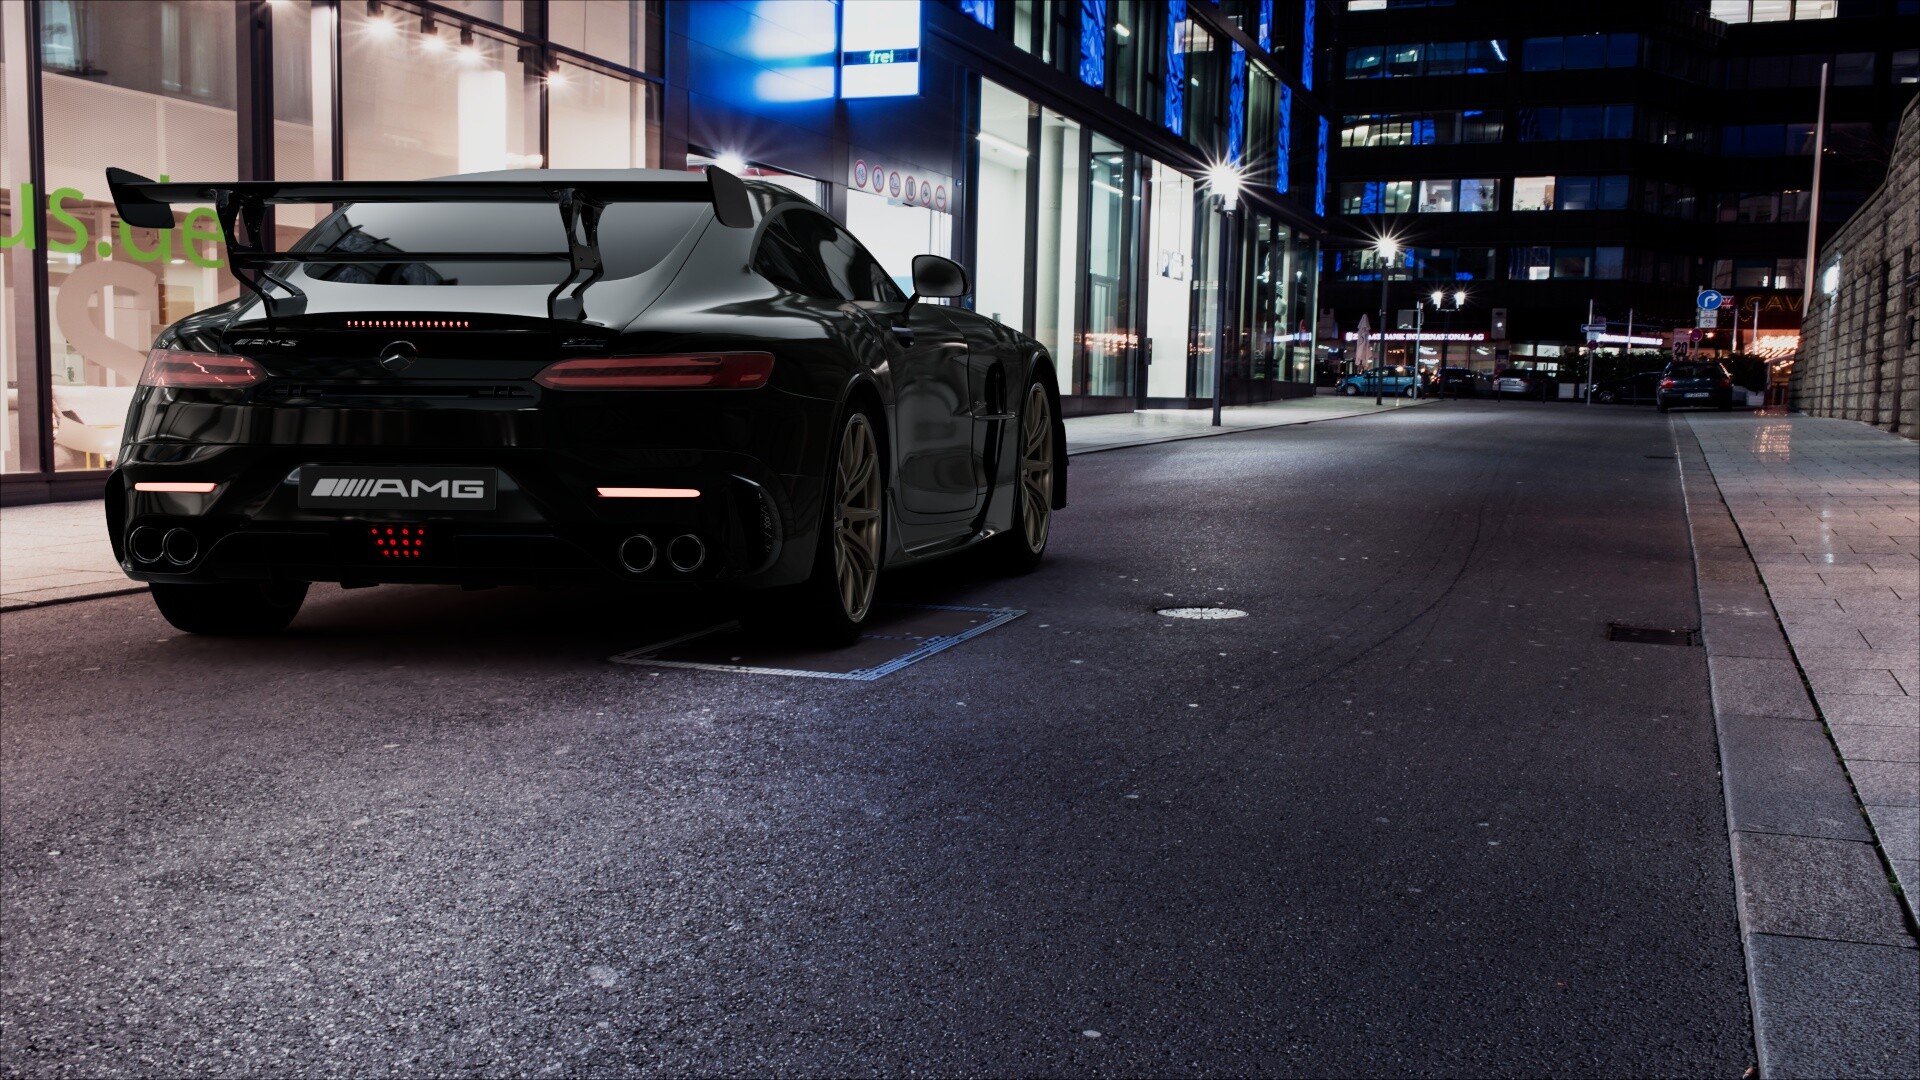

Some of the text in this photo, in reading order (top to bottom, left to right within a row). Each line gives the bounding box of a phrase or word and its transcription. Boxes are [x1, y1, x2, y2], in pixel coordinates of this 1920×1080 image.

[868, 50, 894, 64] frei
[1472, 333, 1485, 341] AG
[1674, 341, 1688, 356] 20
